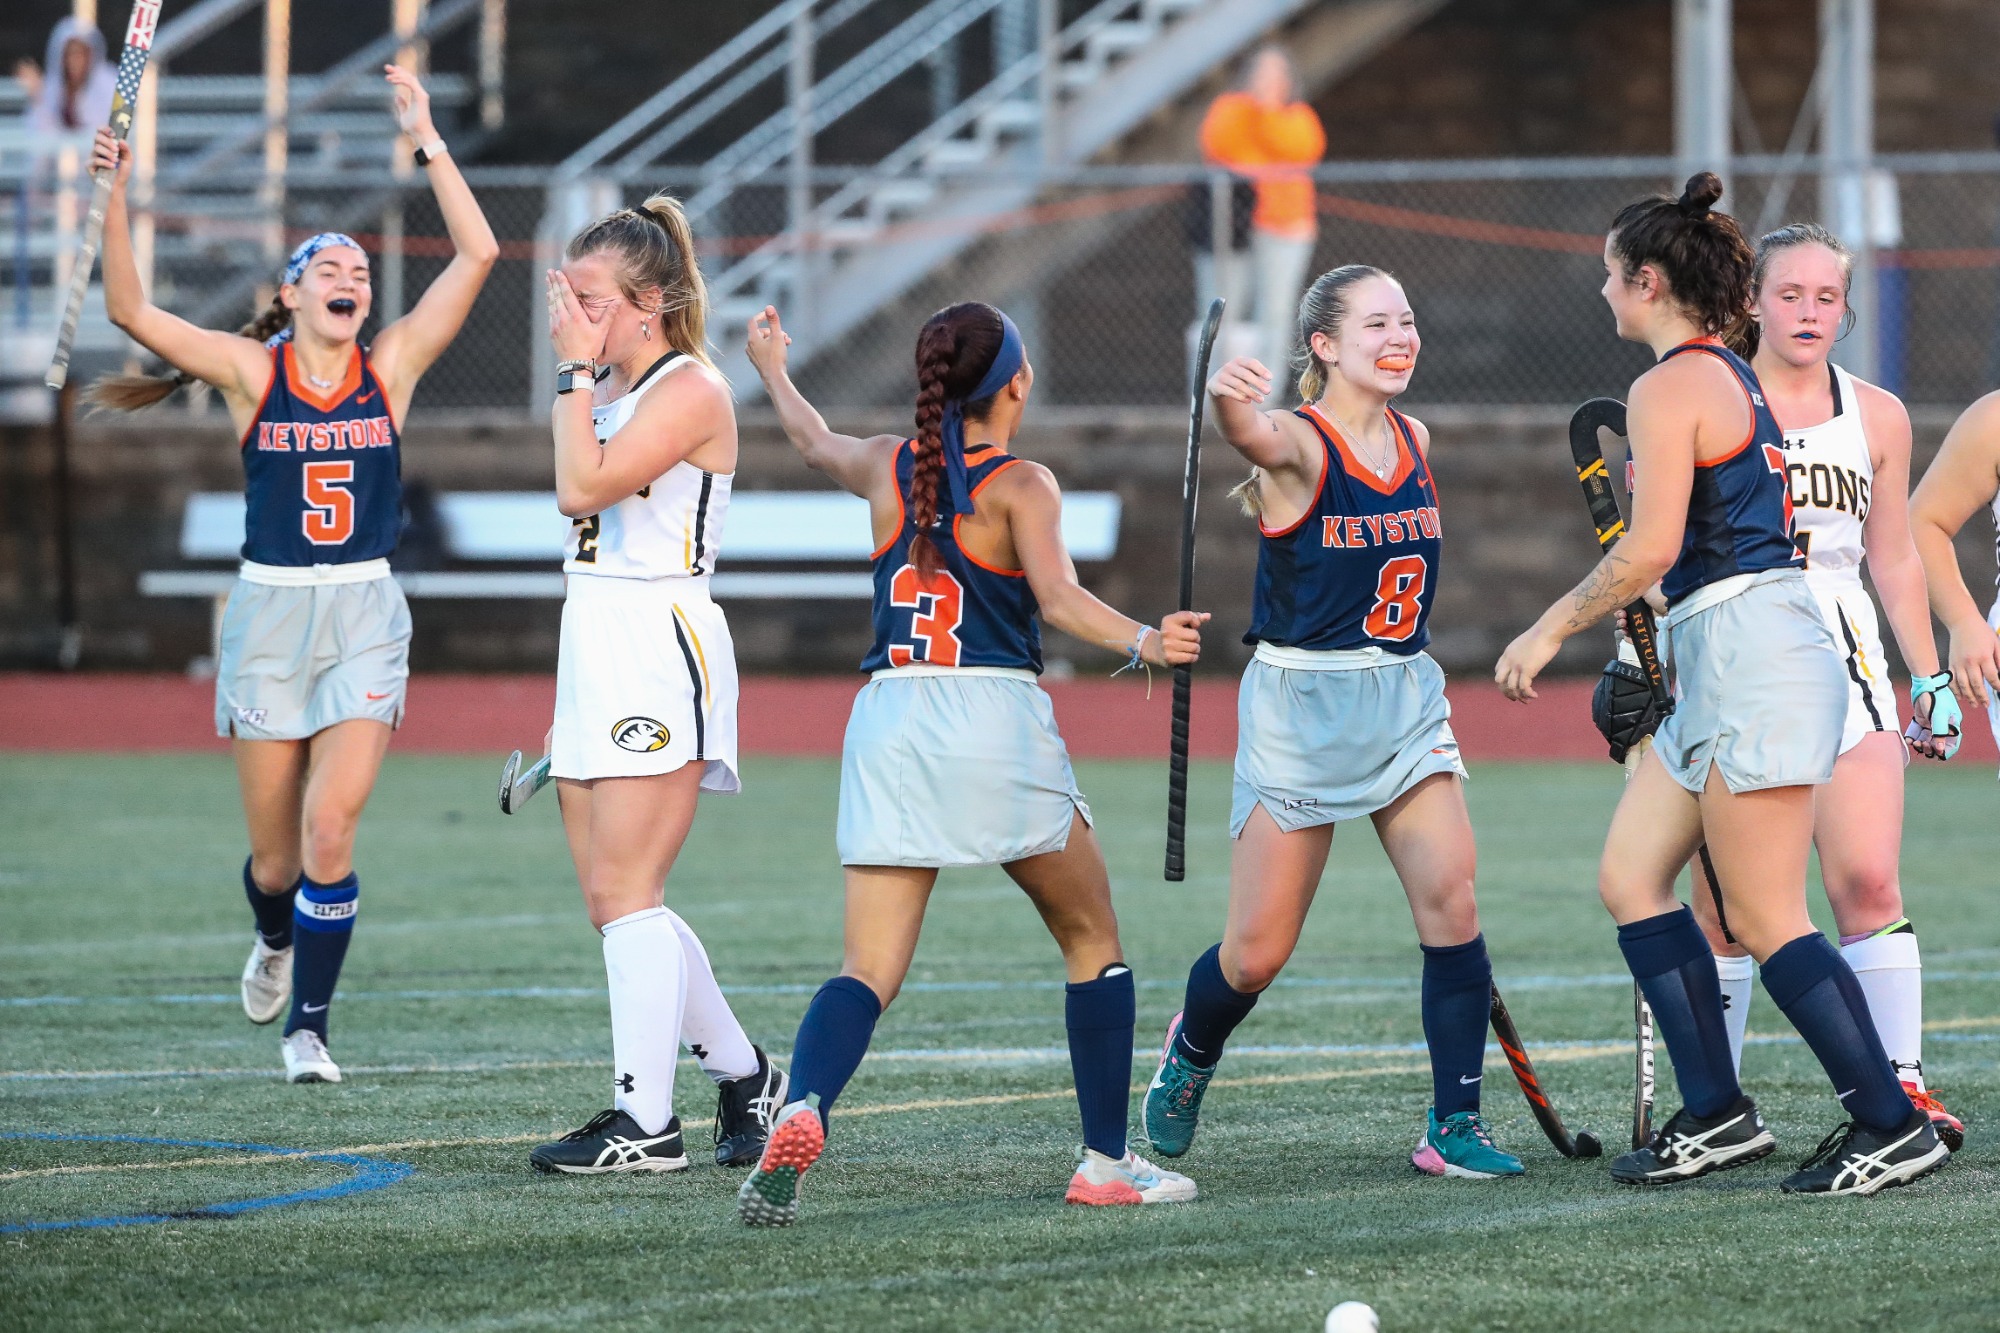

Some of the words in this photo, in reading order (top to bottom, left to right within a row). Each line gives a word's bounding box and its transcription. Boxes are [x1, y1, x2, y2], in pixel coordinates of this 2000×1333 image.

[258, 416, 393, 452] KEYSTONE
[302, 460, 355, 546] 5
[572, 513, 600, 565] 2
[888, 563, 964, 668] 3
[1362, 554, 1428, 642] 8
[1632, 613, 1661, 686] RITUAL
